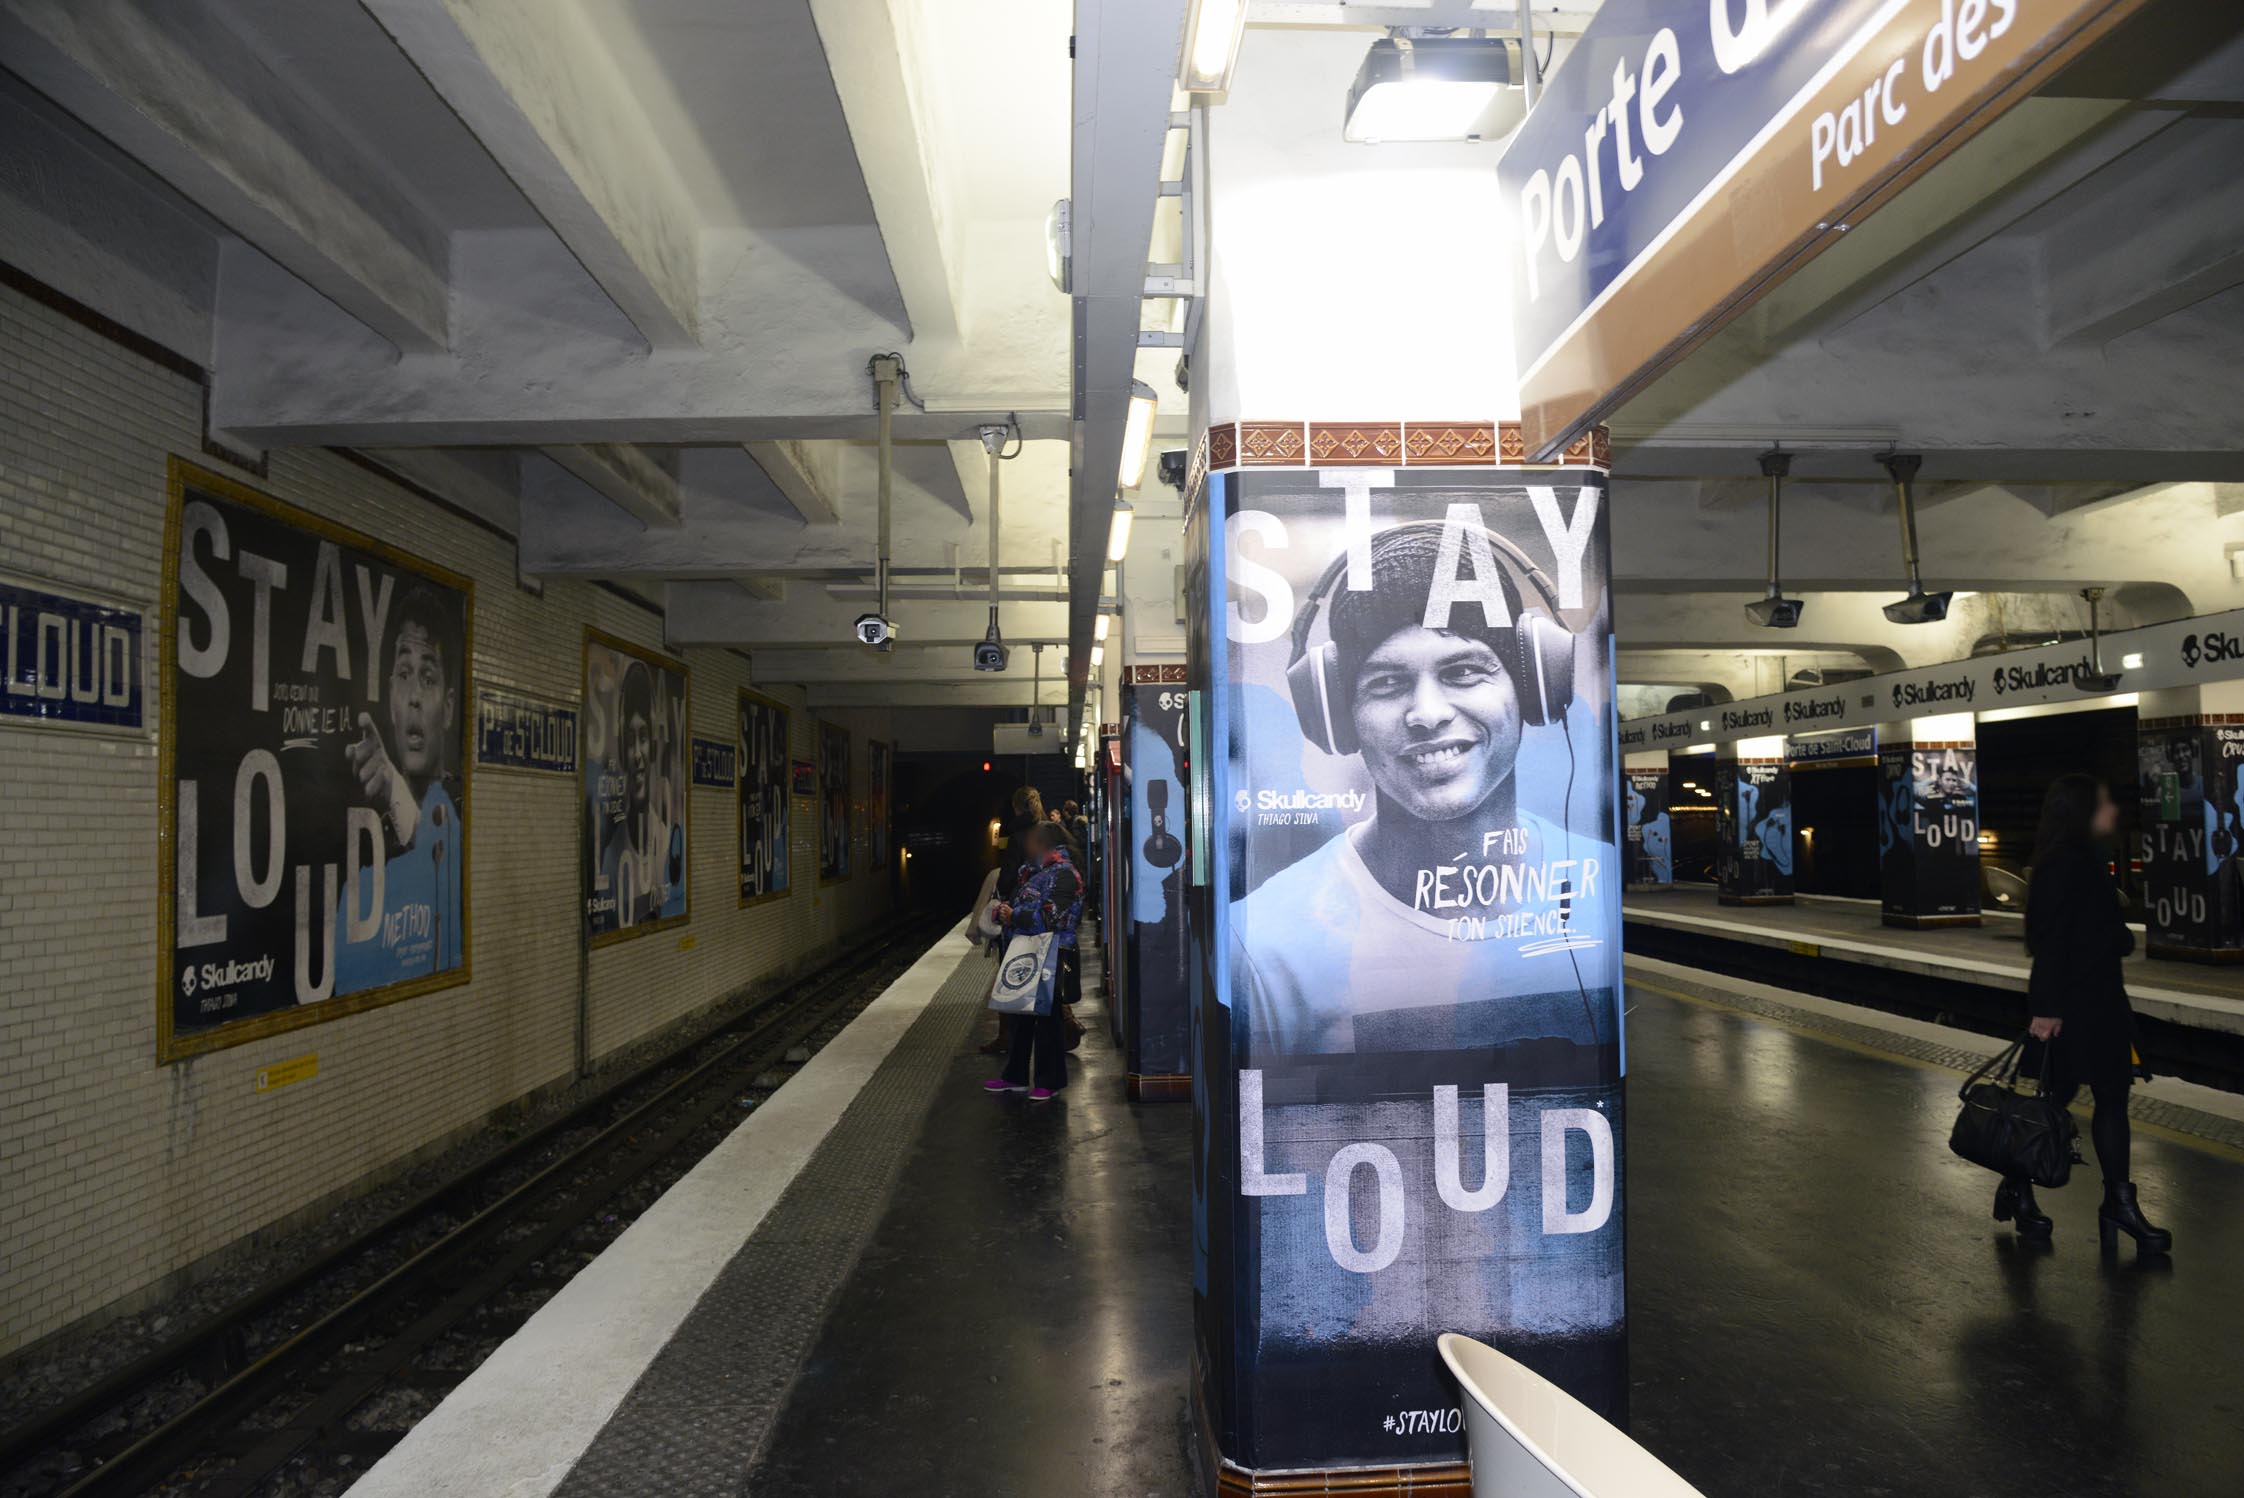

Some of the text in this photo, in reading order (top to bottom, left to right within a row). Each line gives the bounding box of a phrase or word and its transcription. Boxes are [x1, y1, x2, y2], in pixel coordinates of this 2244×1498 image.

[1811, 58, 1906, 193] Parc
[1520, 28, 1684, 303] Porte
[1225, 470, 1602, 645] STAY
[178, 501, 395, 712] STAY
[0, 604, 130, 707] LOUD
[1792, 696, 1845, 720] Skullcandy
[1903, 675, 1975, 706] Skullcandy
[283, 706, 319, 734] DONNE
[1728, 707, 1773, 729] Skullcandy
[531, 712, 573, 764] CLOUD
[1808, 739, 1818, 755] de
[1820, 734, 1871, 754] Saint-Cloud
[1912, 749, 1974, 782] STAY
[1256, 789, 1366, 812] Skullcandy
[1258, 813, 1319, 826] THIAGO SILVA
[1914, 812, 1974, 848] LOUD
[1483, 828, 1528, 857] FAIS
[2142, 824, 2203, 863] STAY
[177, 749, 385, 1005] LOUD
[1414, 852, 1600, 911] RÉSONNER
[2144, 881, 2206, 928] LOUD
[1448, 908, 1577, 943] TON SILENCE.
[200, 953, 274, 990] Skullcandy
[1239, 1069, 1615, 1274] LOUD
[1383, 1406, 1466, 1435] #STAYLO
